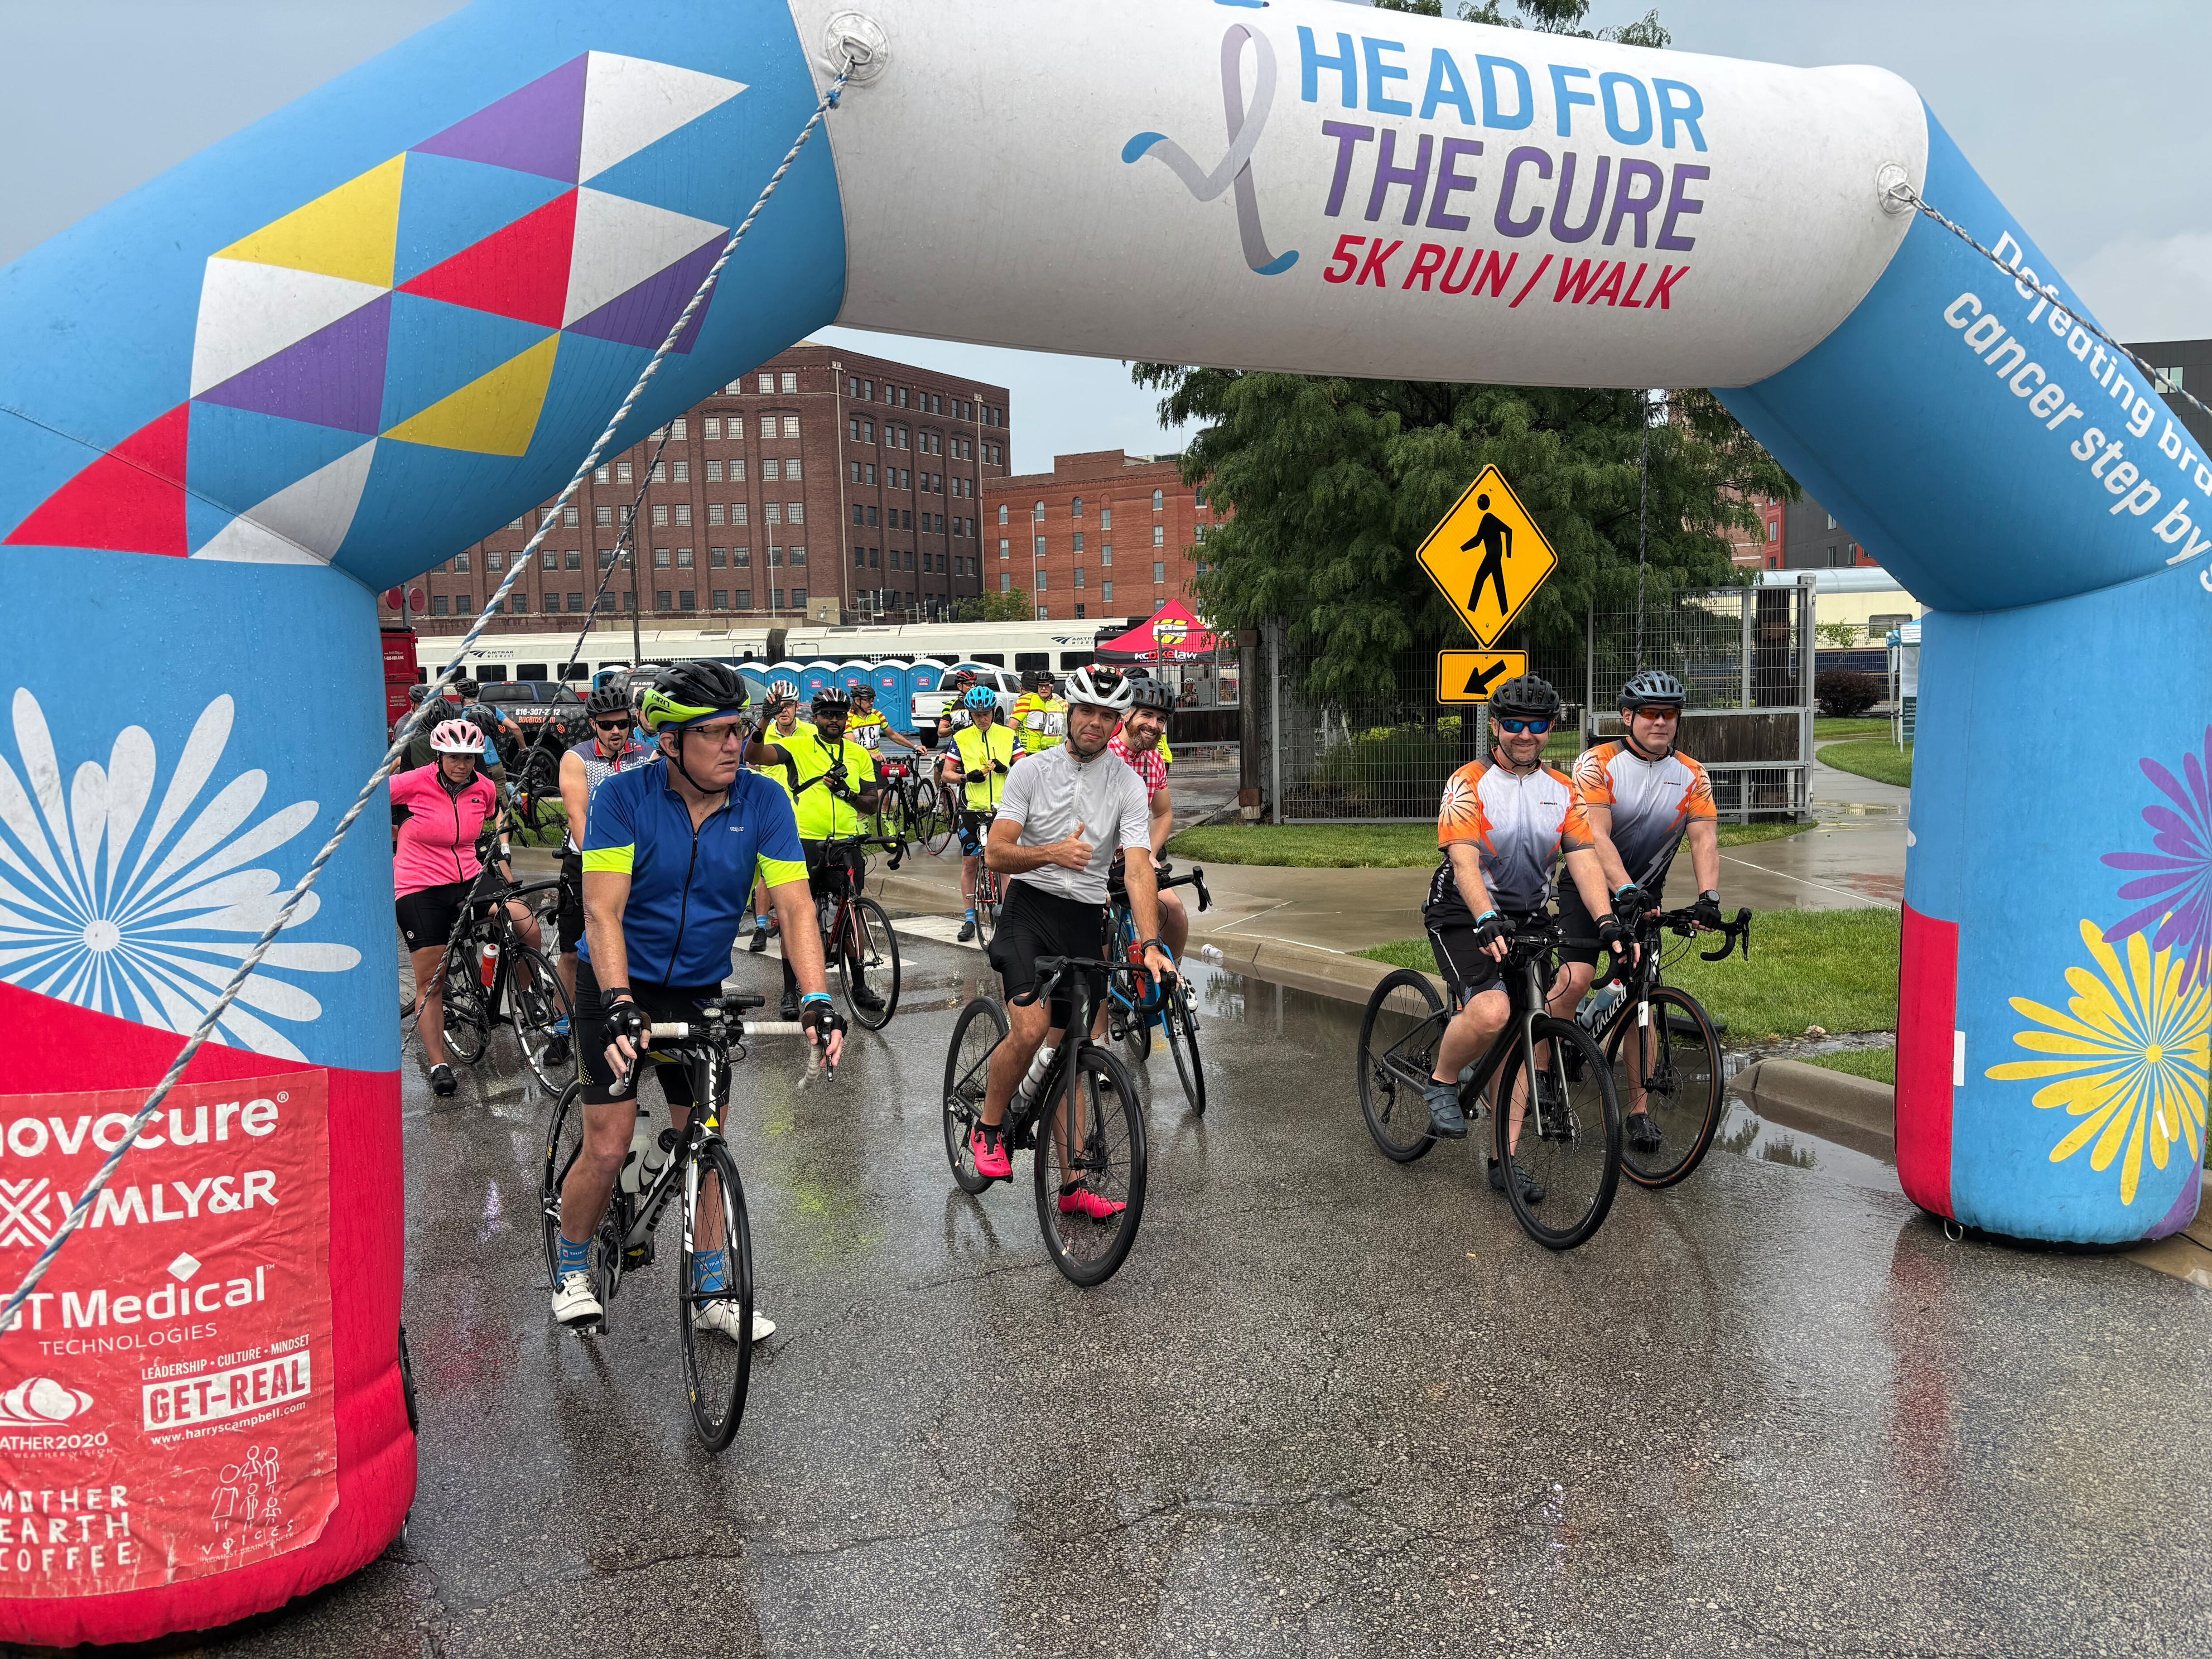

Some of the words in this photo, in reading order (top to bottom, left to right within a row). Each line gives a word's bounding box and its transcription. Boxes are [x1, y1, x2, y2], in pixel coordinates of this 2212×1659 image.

[1297, 25, 1533, 131] HEAD
[1548, 64, 1708, 152] FOR
[1322, 119, 1484, 232] THE
[1493, 146, 1711, 252] CURE
[1323, 234, 1404, 288] 5K
[1401, 243, 1519, 297] RUN
[1553, 257, 1690, 310] WALK
[1991, 230, 2155, 438] Defeating
[1943, 292, 2084, 431] cancer
[2070, 427, 2161, 515] step
[2151, 498, 2212, 566] by
[869, 726, 875, 740] C
[707, 1045, 716, 1112] FUJI
[38, 1323, 218, 1356] TECHNOLOGIES
[141, 1359, 208, 1381] LEADERSHIP
[217, 1347, 262, 1368] CULTURE
[271, 1334, 310, 1356] MINDSET
[150, 1359, 306, 1425] GET-REAL
[151, 1401, 306, 1445] www.harryscampbell.com
[0, 1512, 131, 1545] EARTH
